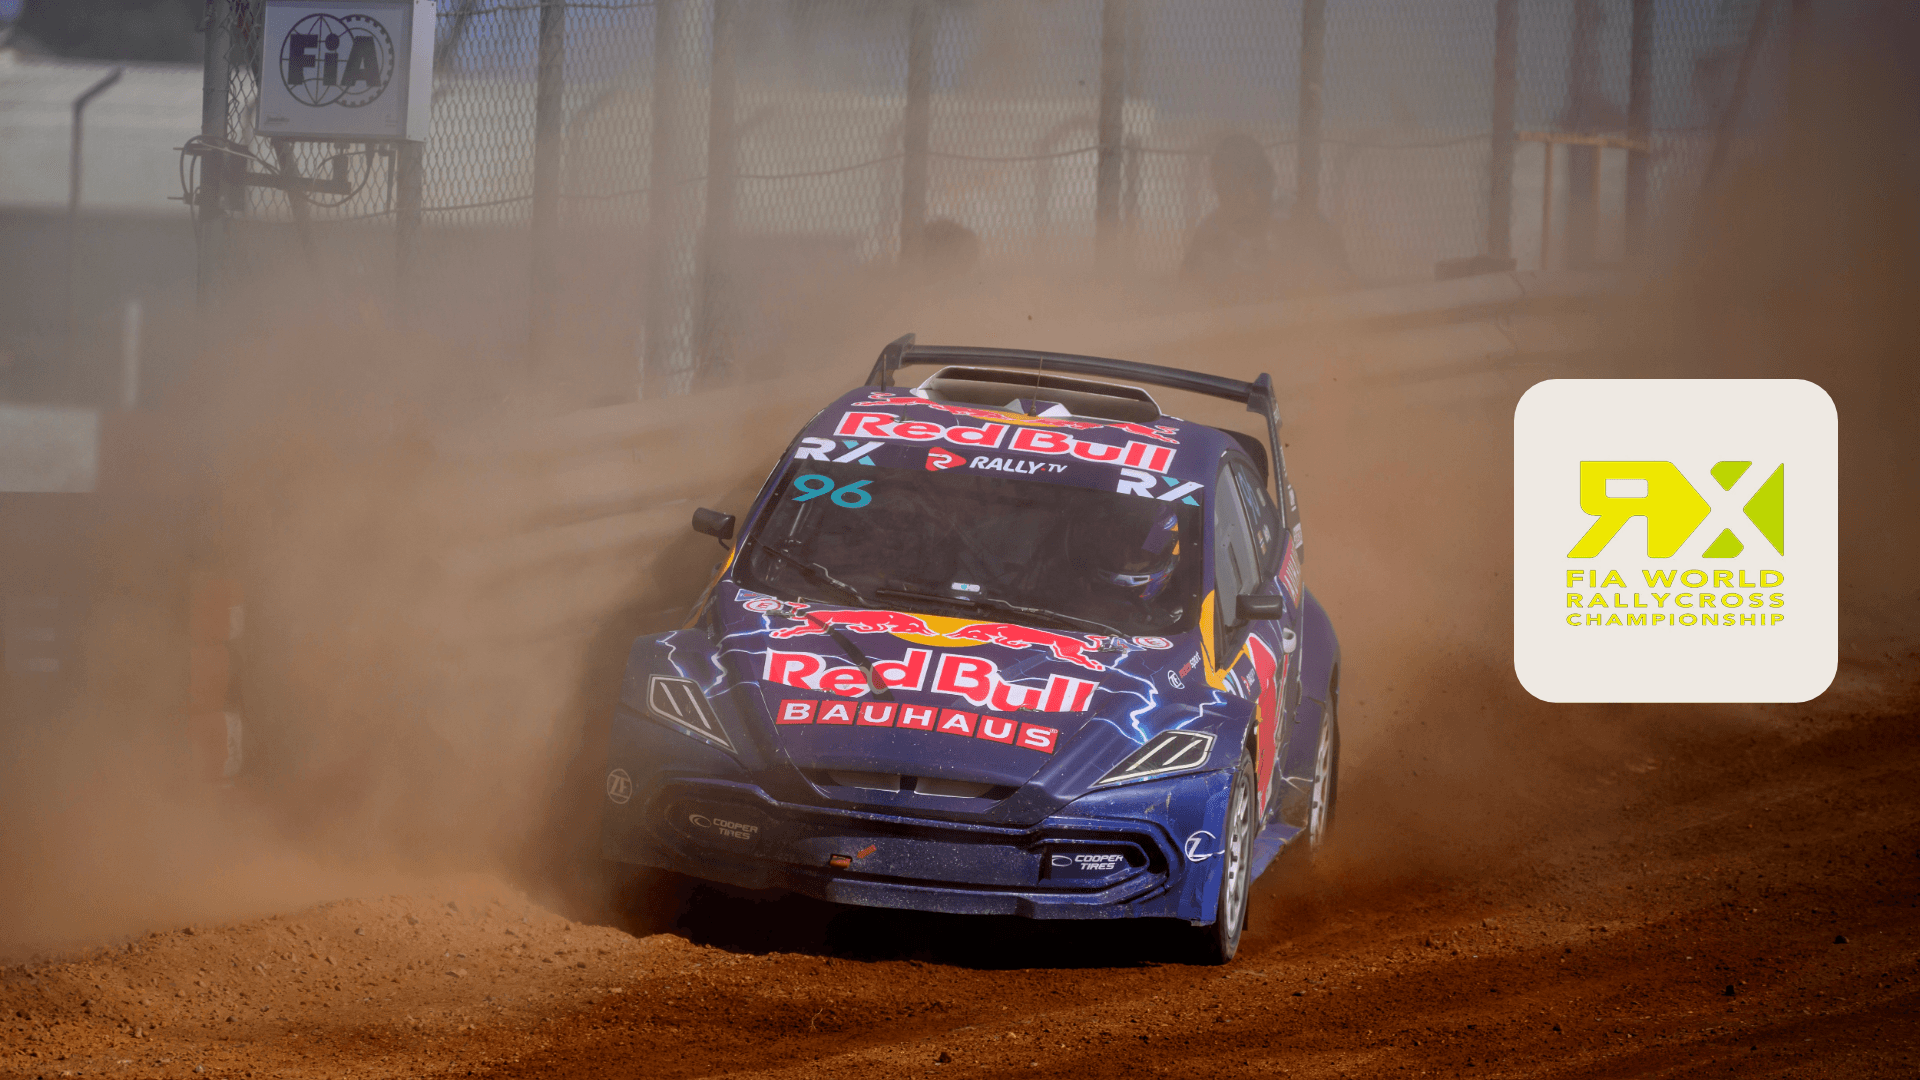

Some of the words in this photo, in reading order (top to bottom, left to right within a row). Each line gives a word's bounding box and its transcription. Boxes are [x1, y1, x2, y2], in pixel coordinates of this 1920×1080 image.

[834, 411, 1010, 449] Red
[1008, 427, 1177, 474] Bull
[792, 474, 873, 508] 96
[763, 647, 933, 698] Red
[931, 653, 1100, 712] Bull
[784, 702, 1052, 748] BAUHAUS
[713, 818, 758, 833] COOPER
[1074, 854, 1124, 863] COOPER
[1080, 862, 1116, 870] TIRES
